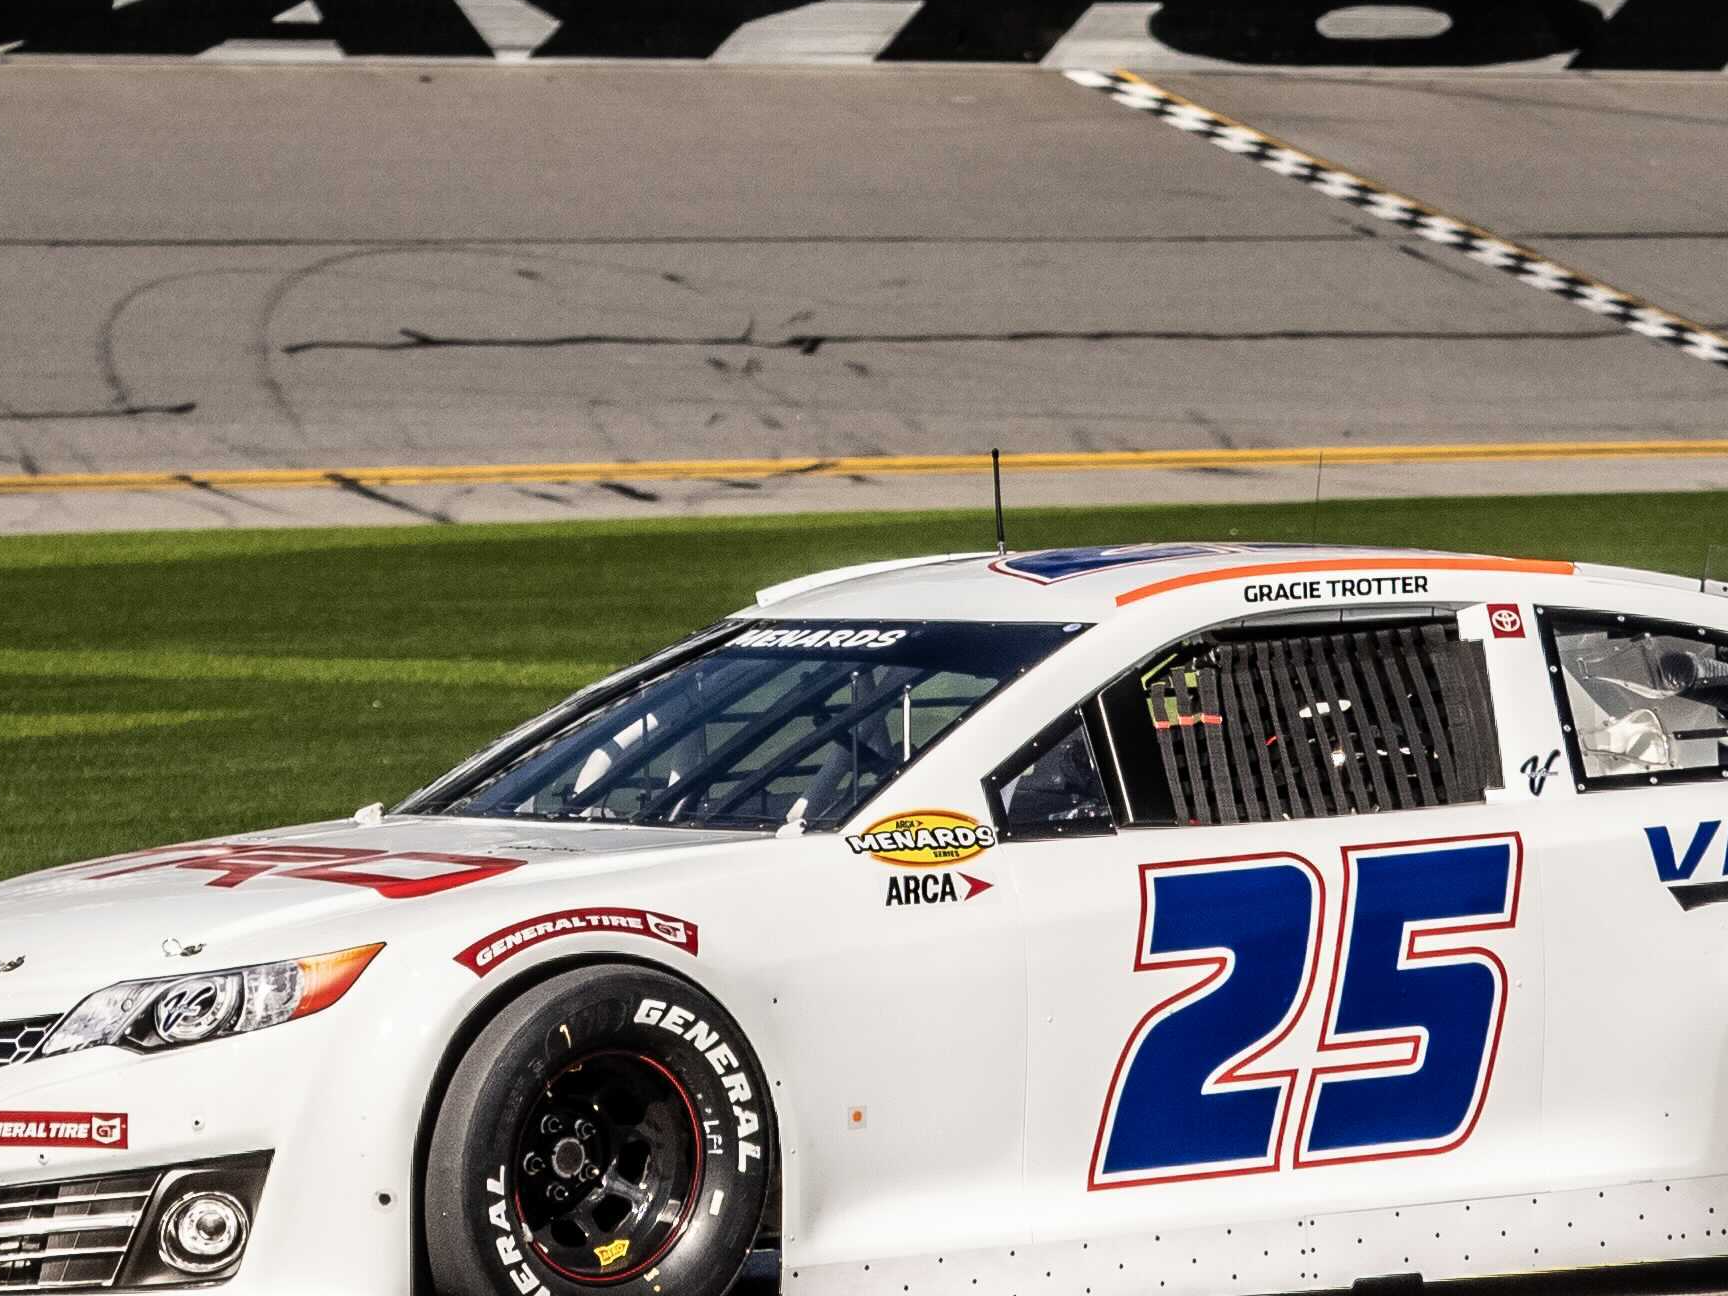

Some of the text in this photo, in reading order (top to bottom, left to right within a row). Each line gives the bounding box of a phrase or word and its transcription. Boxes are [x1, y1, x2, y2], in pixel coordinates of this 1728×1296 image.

[1244, 575, 1429, 603] GRACIE TROTTER
[724, 629, 907, 648] MENARDS
[895, 820, 915, 829] ARCA
[845, 825, 996, 854] MENARDS
[885, 872, 958, 906] ARCA
[475, 913, 644, 967] GENERAL TIRE
[1087, 830, 1523, 1192] 25
[633, 998, 761, 1173] GENERAL
[48, 1122, 90, 1138] TIRE
